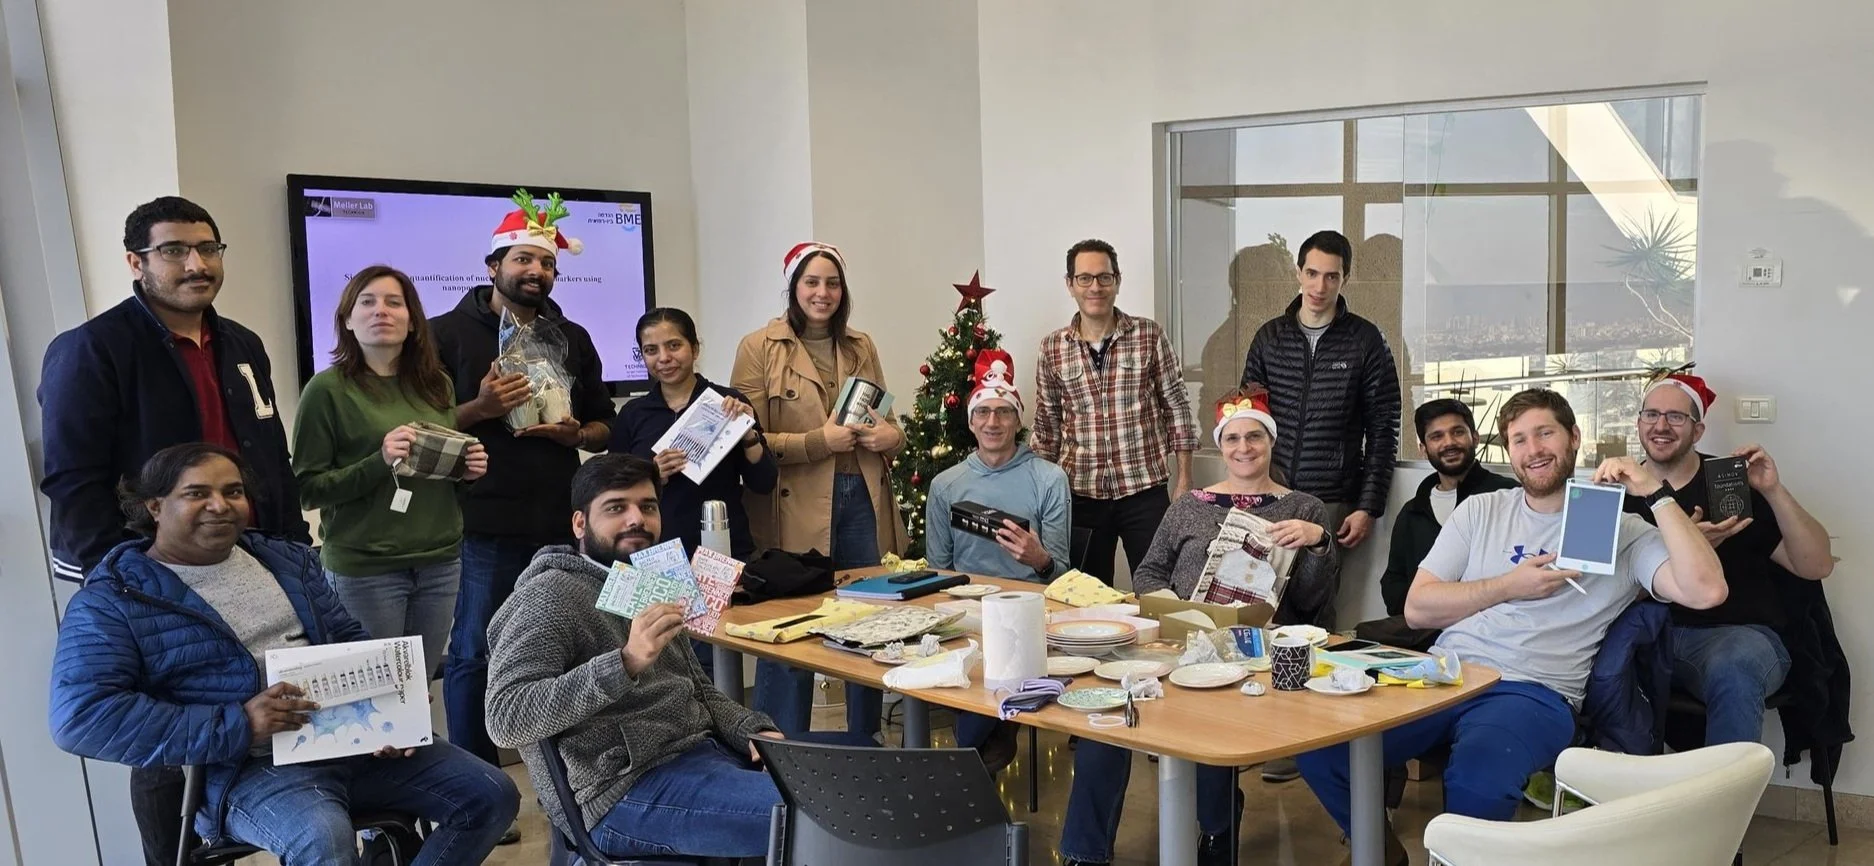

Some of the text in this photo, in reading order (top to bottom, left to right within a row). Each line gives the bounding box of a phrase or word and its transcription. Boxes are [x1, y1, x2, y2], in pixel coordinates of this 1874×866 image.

[359, 202, 373, 210] Lab
[616, 213, 641, 225] BME
[410, 274, 464, 283] quantification
[466, 274, 475, 282] of
[583, 276, 602, 284] using
[237, 363, 274, 420] L
[393, 641, 404, 682] Watercolour
